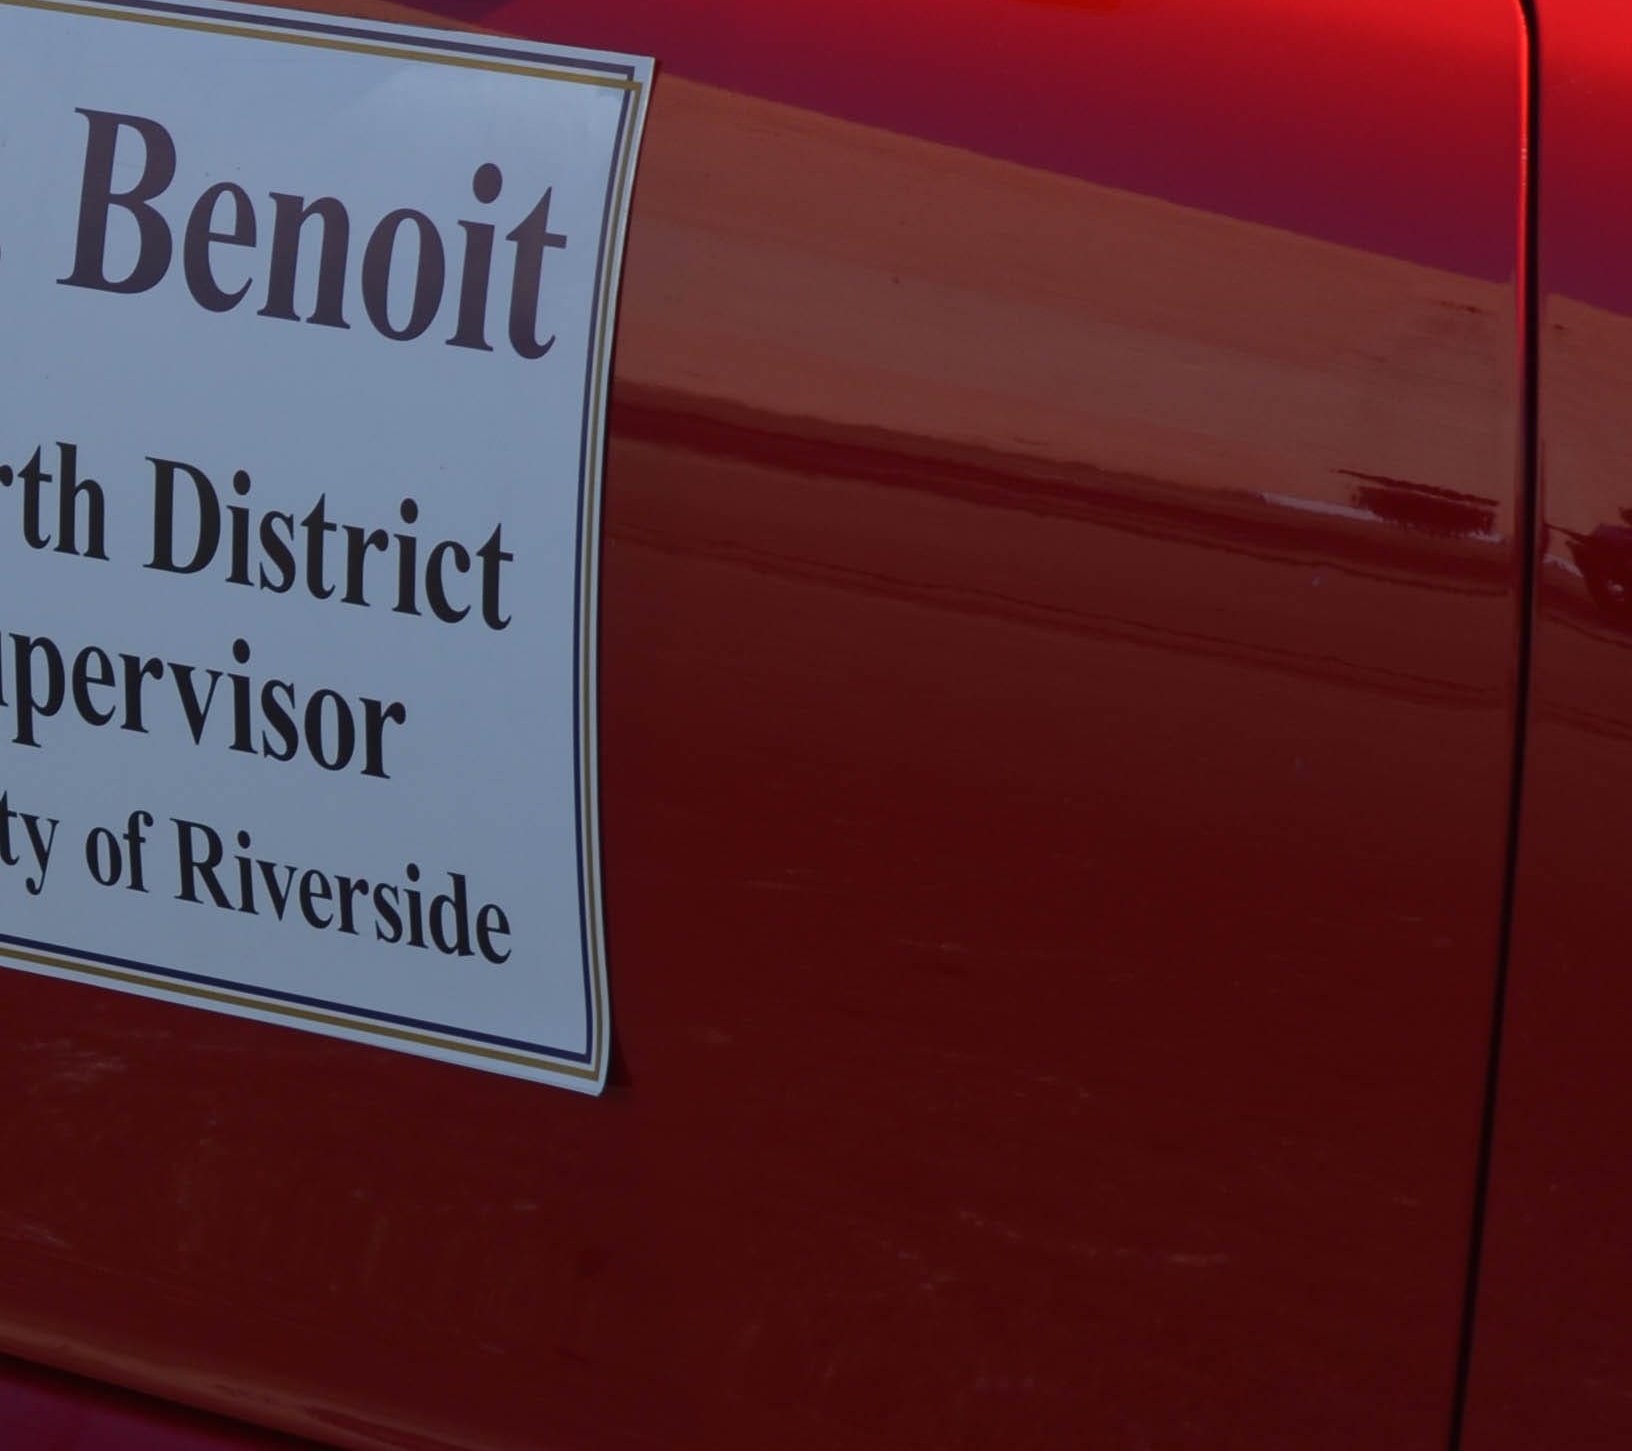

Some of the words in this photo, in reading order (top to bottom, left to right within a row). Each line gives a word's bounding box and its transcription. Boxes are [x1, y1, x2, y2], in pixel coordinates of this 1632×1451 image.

[55, 107, 567, 360] Benoit
[142, 456, 514, 631] District
[85, 809, 154, 894] of
[169, 817, 512, 965] Riverside
